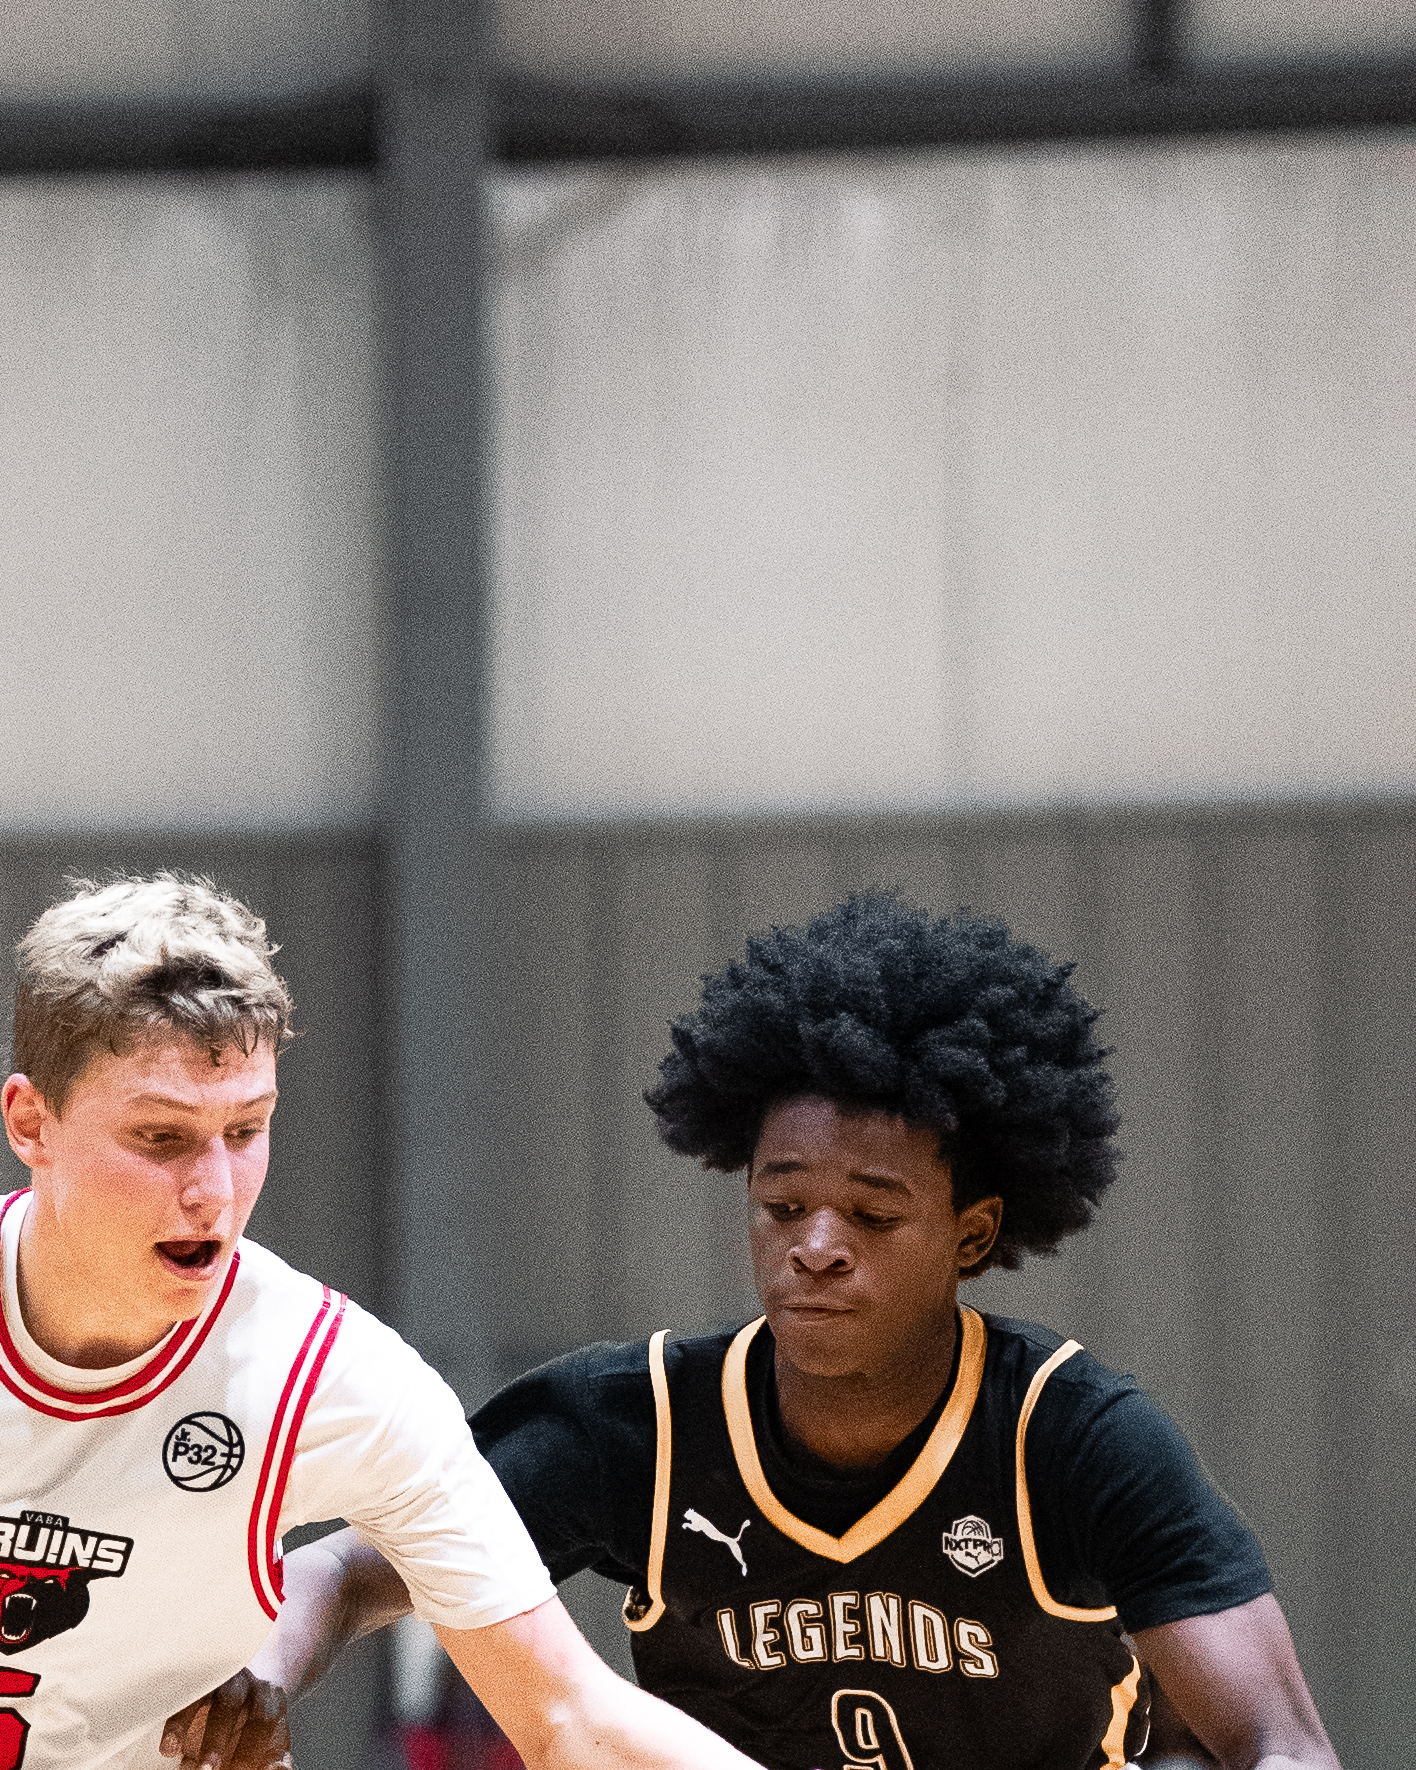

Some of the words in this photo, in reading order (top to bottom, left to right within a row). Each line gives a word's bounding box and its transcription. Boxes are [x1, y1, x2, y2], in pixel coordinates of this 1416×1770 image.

[175, 1428, 191, 1442] Jr.
[172, 1442, 217, 1466] P32
[26, 1514, 64, 1527] VABA
[717, 1591, 999, 1678] LEGENDS
